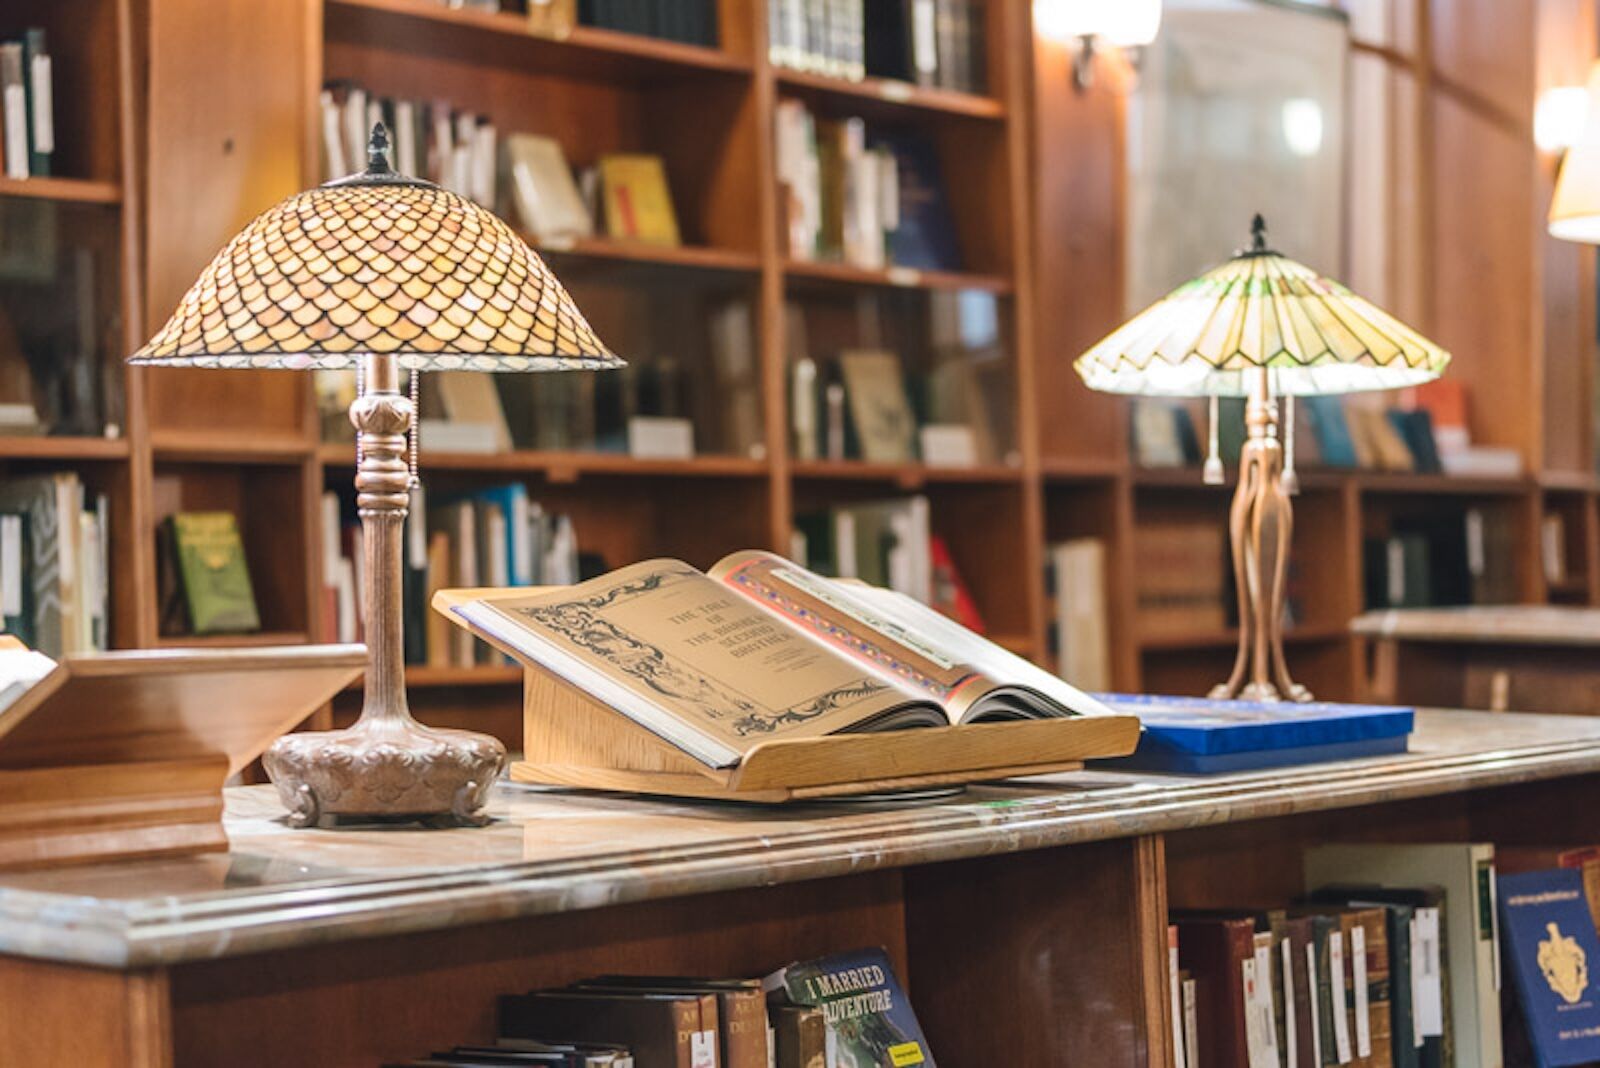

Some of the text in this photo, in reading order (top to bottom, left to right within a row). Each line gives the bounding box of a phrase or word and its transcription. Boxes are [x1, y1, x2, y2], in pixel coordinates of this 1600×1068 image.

[668, 610, 698, 624] THE
[683, 631, 715, 646] THE
[805, 964, 885, 999] I MARRIED
[822, 989, 893, 1025] ADVENTURE
